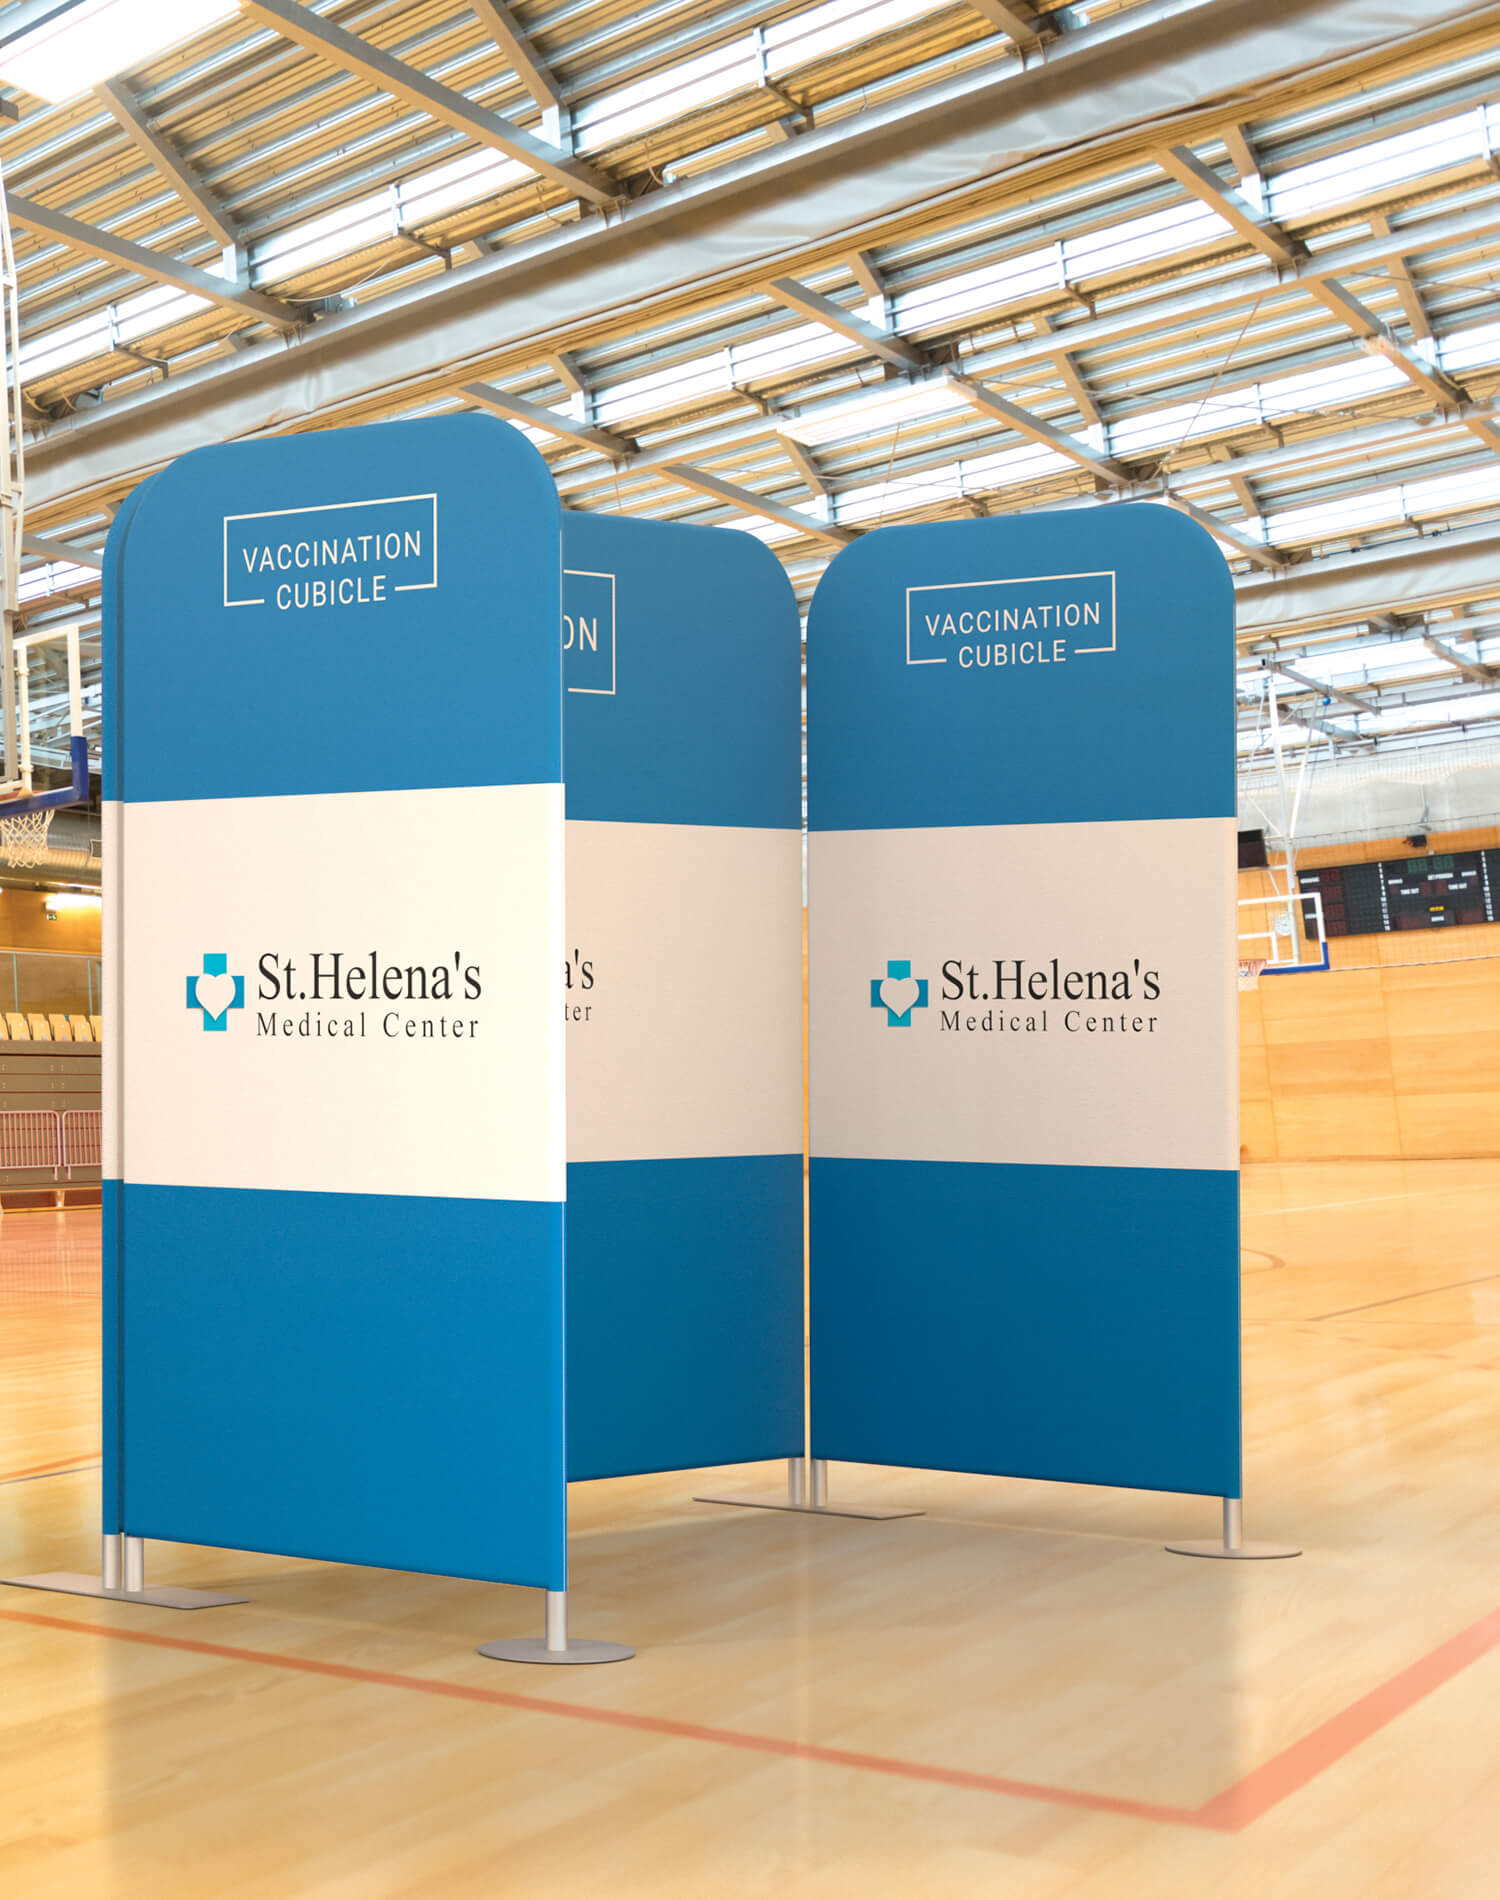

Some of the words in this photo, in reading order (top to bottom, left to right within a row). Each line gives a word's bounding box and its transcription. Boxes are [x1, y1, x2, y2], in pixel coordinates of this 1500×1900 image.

[242, 530, 421, 573] VACCINATION
[276, 575, 387, 610] CUBICLE
[925, 601, 1100, 636] VACCINATION
[958, 639, 1067, 669] CUBICLE
[258, 950, 482, 1000] St.Helena's
[941, 958, 1161, 1001] St.Helena's
[256, 1012, 366, 1037] Medical
[383, 1012, 479, 1038] Center
[565, 1002, 592, 1021] ter
[940, 1010, 1048, 1032] Medical
[1064, 1010, 1158, 1033] Center
